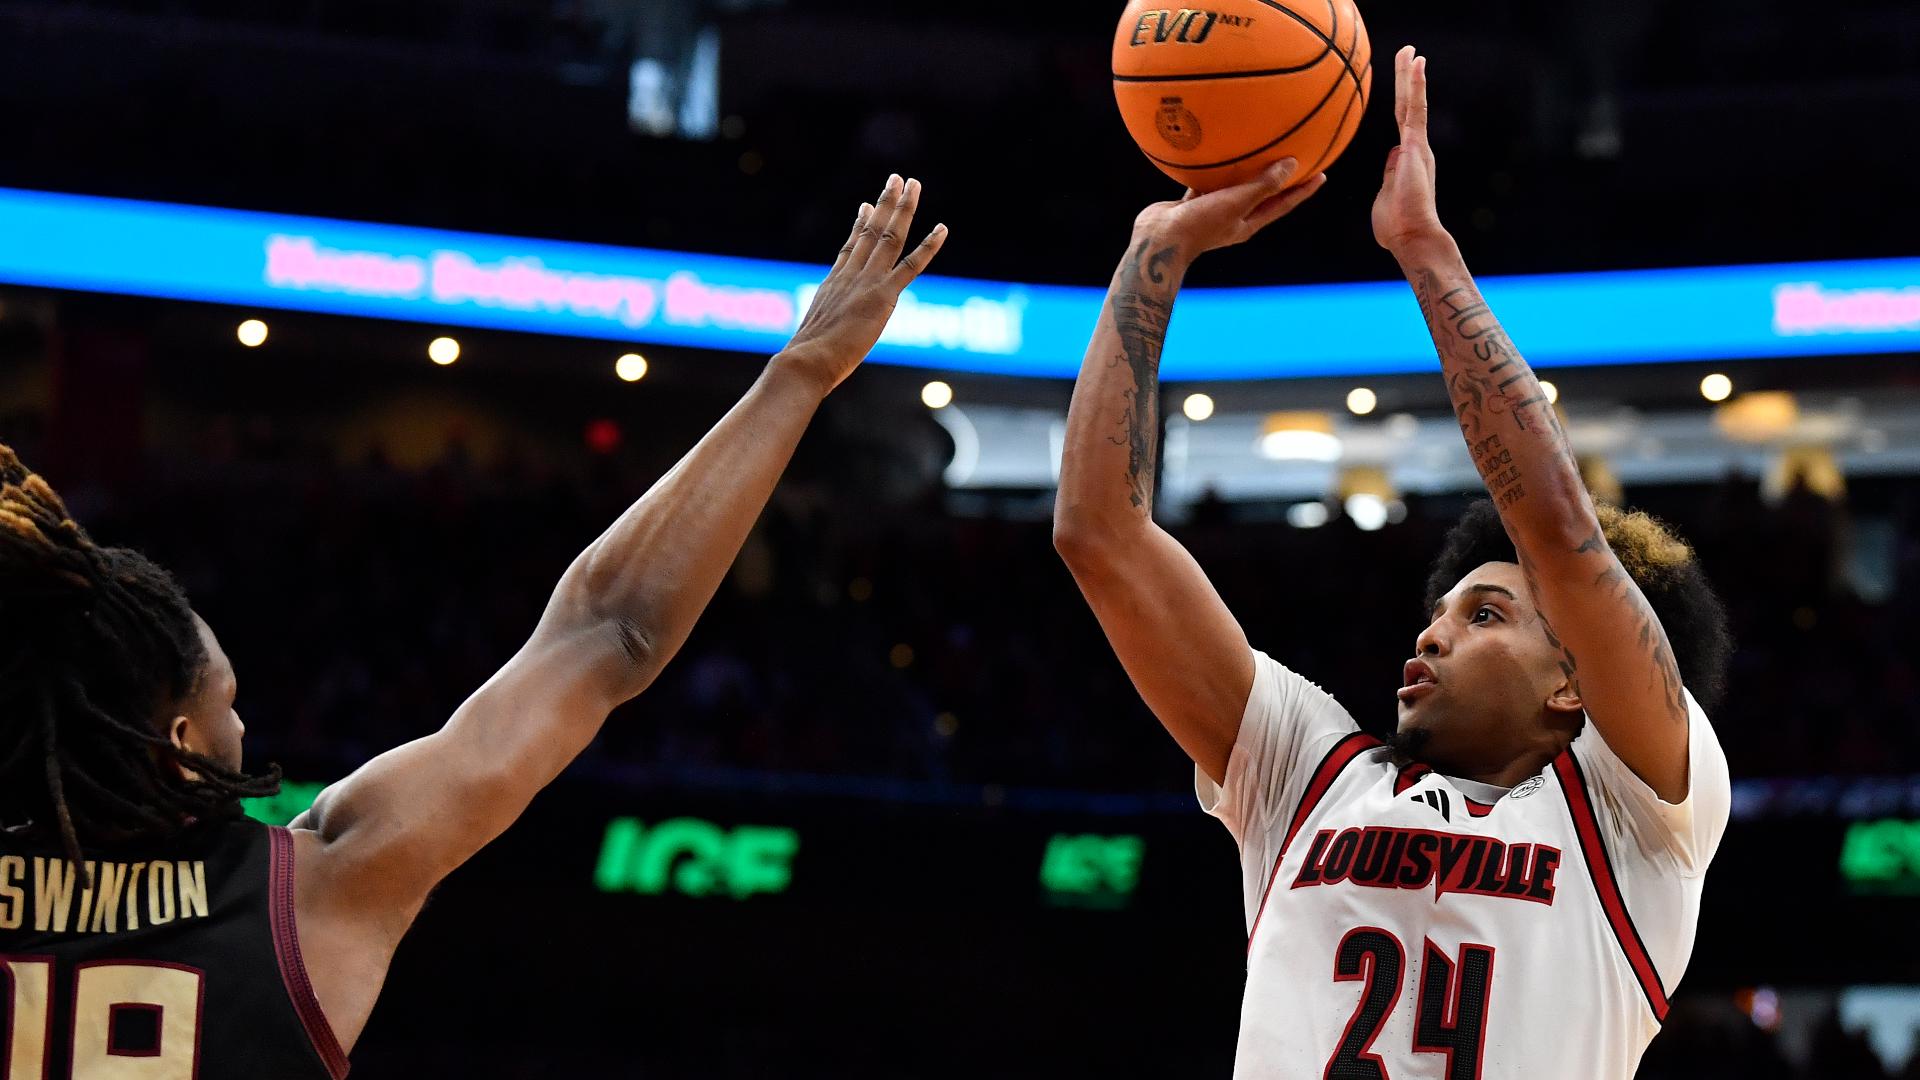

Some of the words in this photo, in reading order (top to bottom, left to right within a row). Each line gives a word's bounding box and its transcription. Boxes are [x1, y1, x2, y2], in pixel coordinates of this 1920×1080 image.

[1129, 9, 1217, 46] EVO
[0, 855, 209, 933] SWINTON
[1290, 826, 1562, 906] LOUISVILLE
[1322, 926, 1496, 1080] 24
